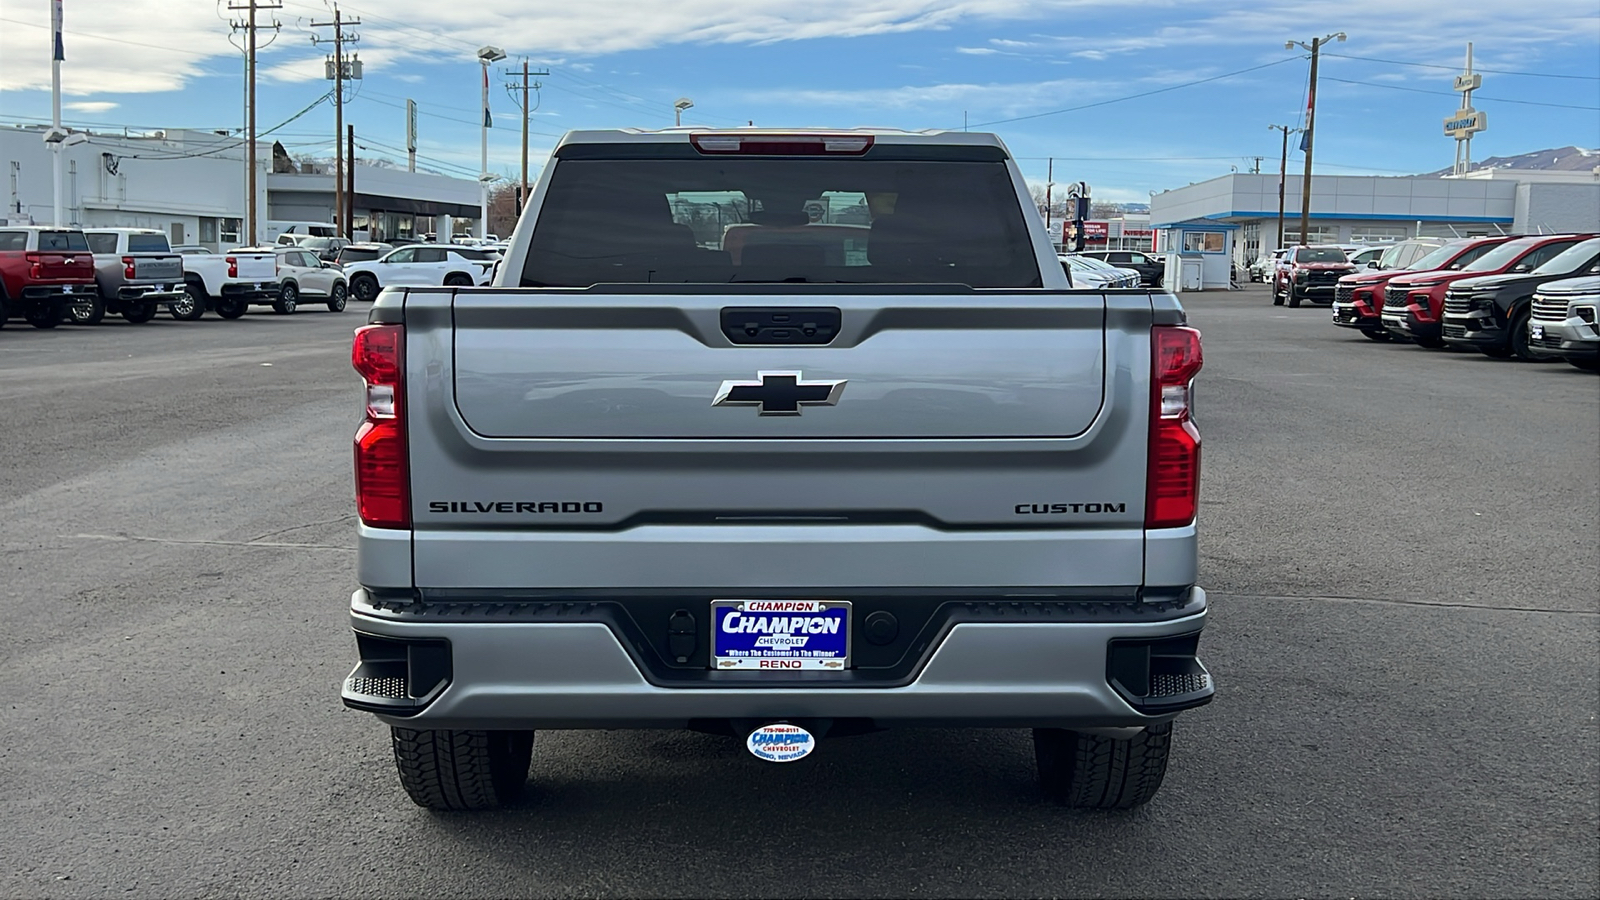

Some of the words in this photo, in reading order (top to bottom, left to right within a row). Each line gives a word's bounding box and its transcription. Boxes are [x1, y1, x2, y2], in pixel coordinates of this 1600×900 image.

[429, 501, 603, 513] SILVERADO
[1015, 503, 1126, 514] CUSTOM
[749, 602, 813, 611] CHAMPION
[722, 612, 841, 634] CHAMPION
[758, 637, 805, 645] CHEVROLET
[760, 660, 802, 668] RENO
[778, 749, 808, 760] NEVADA
